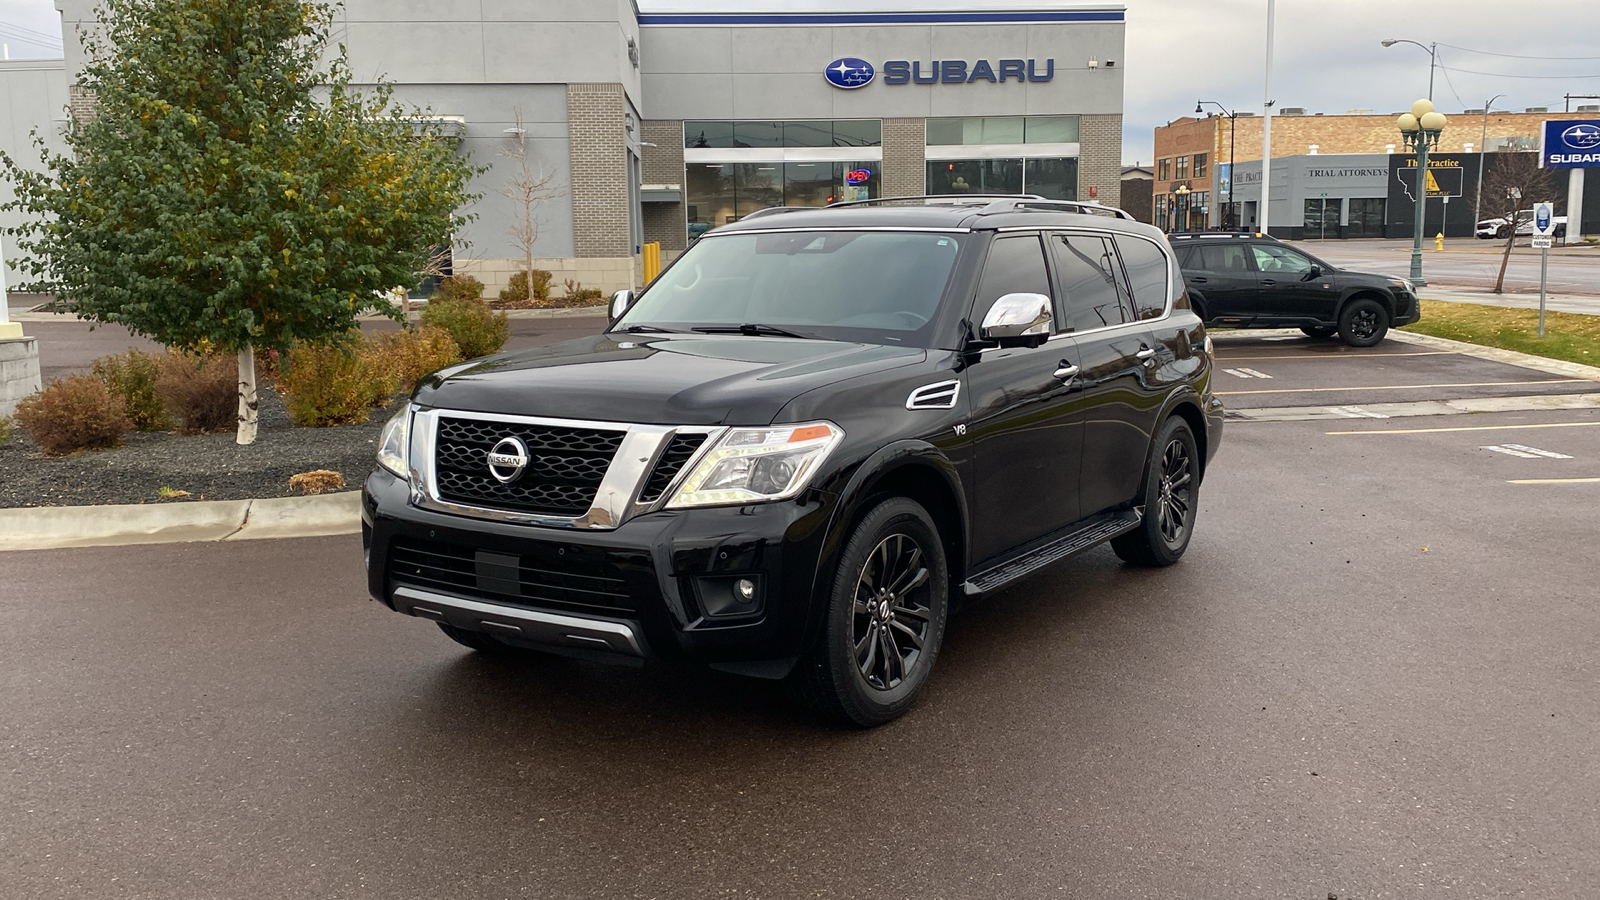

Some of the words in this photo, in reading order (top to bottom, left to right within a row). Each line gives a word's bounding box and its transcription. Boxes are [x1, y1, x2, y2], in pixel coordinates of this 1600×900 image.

[883, 59, 1054, 84] SUBARU
[1406, 159, 1418, 167] Th
[1427, 158, 1459, 167] Practice
[1550, 153, 1600, 163] SUBAR
[846, 171, 868, 181] OPEN
[1234, 173, 1243, 183] THE
[1245, 171, 1262, 182] PRACTI
[1309, 169, 1335, 177] TRIAL
[1338, 168, 1388, 177] ATTORNEYS
[952, 423, 966, 437] V8
[489, 456, 520, 465] NISSAN
